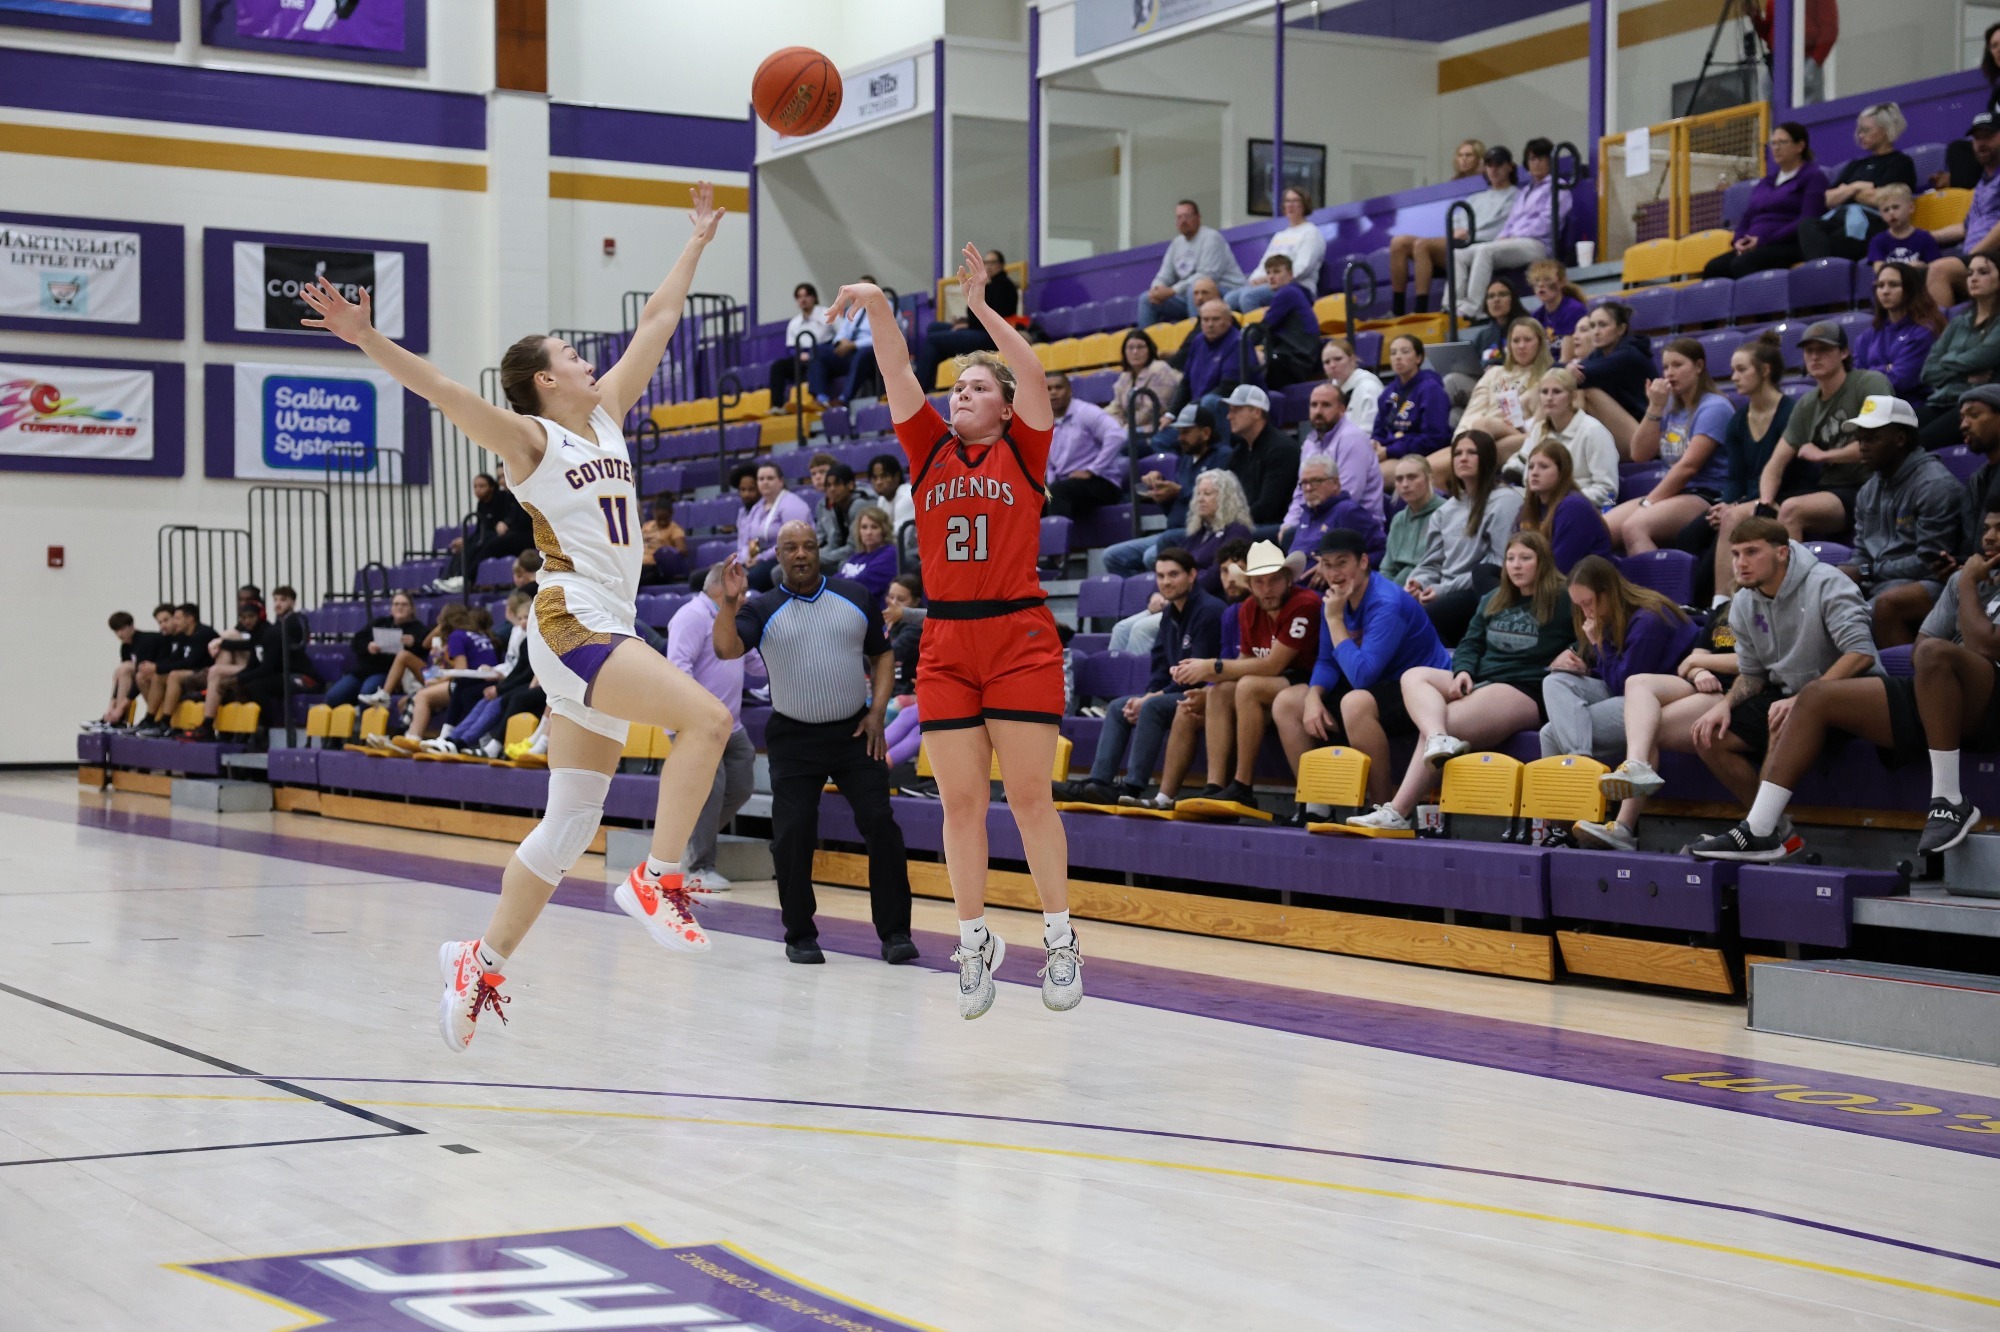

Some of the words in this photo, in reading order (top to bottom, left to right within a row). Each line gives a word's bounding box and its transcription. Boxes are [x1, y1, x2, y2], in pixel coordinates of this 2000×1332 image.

[11, 251, 68, 269] LITTLE
[73, 258, 117, 271] ITALY
[274, 386, 361, 412] Salina
[19, 421, 138, 438] CONSOLIDATED
[274, 409, 352, 434] Waste
[274, 432, 366, 461] Systems
[564, 457, 636, 491] COYOTE
[925, 475, 1015, 513] FRIENDS
[597, 494, 632, 548] 11
[945, 513, 989, 562] 21
[1288, 616, 1309, 639] 6
[1821, 888, 1827, 896] A
